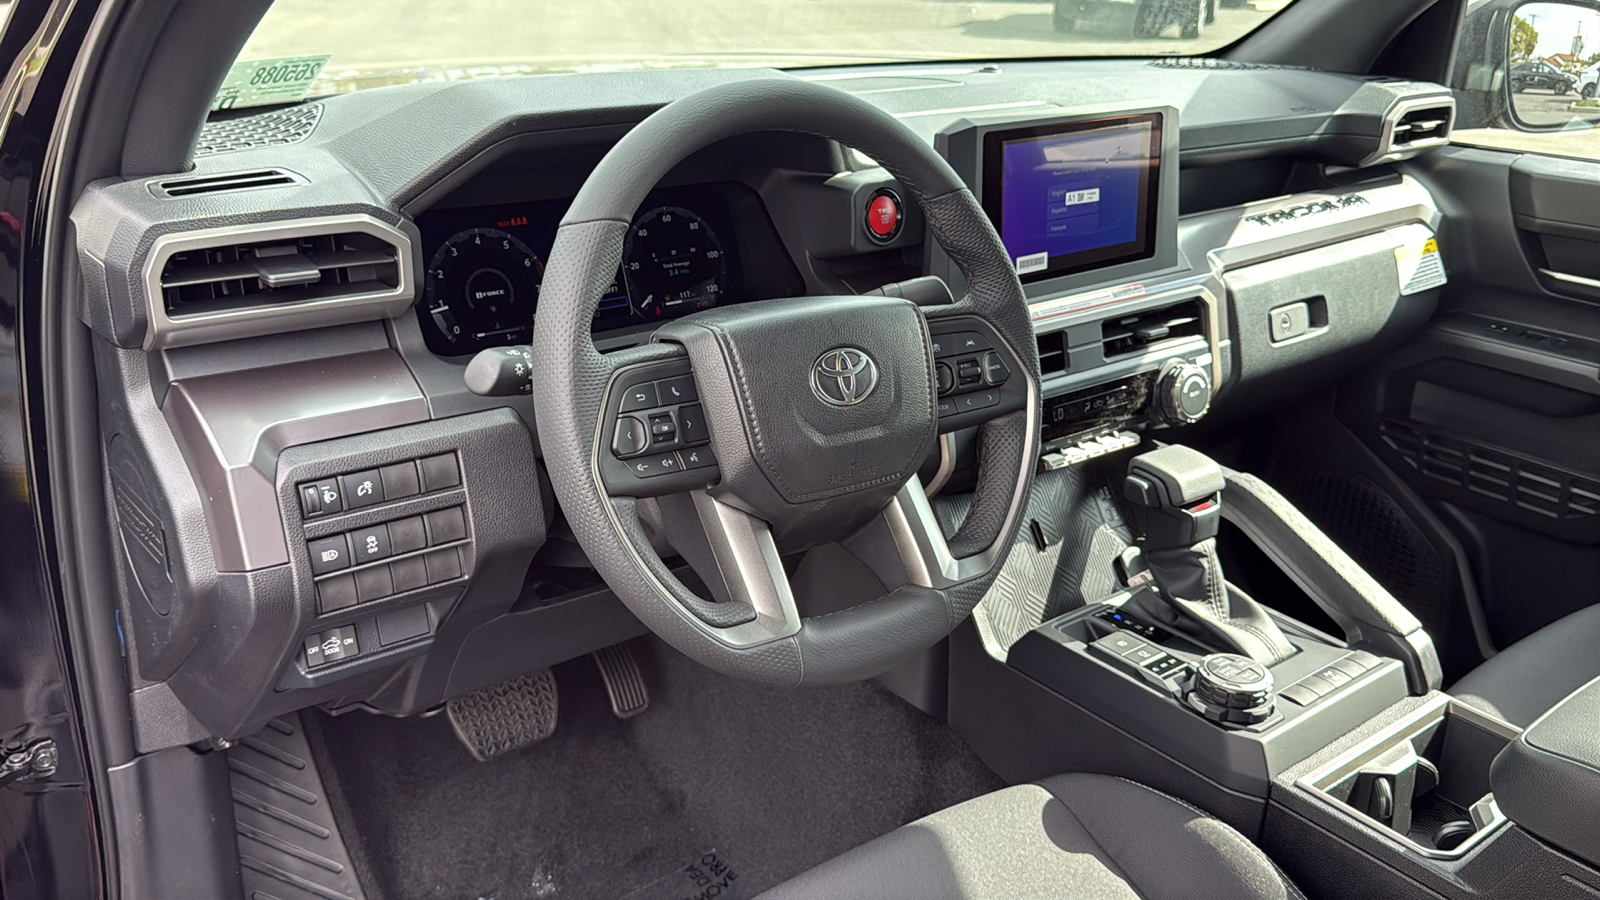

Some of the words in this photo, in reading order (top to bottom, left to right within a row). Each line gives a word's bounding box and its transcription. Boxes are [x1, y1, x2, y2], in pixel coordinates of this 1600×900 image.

[662, 214, 672, 223] 60
[689, 222, 699, 230] 80
[638, 229, 648, 237] 40
[503, 240, 510, 250] 5
[451, 247, 458, 257] 3
[706, 250, 719, 259] 100
[524, 258, 531, 267] 6
[630, 262, 640, 270] 20
[437, 269, 444, 279] 2
[706, 284, 719, 293] 120
[679, 290, 690, 299] 117
[453, 325, 461, 335] 0
[343, 637, 354, 646] ON
[308, 646, 320, 655] OFF
[324, 647, 341, 656] DOOR
